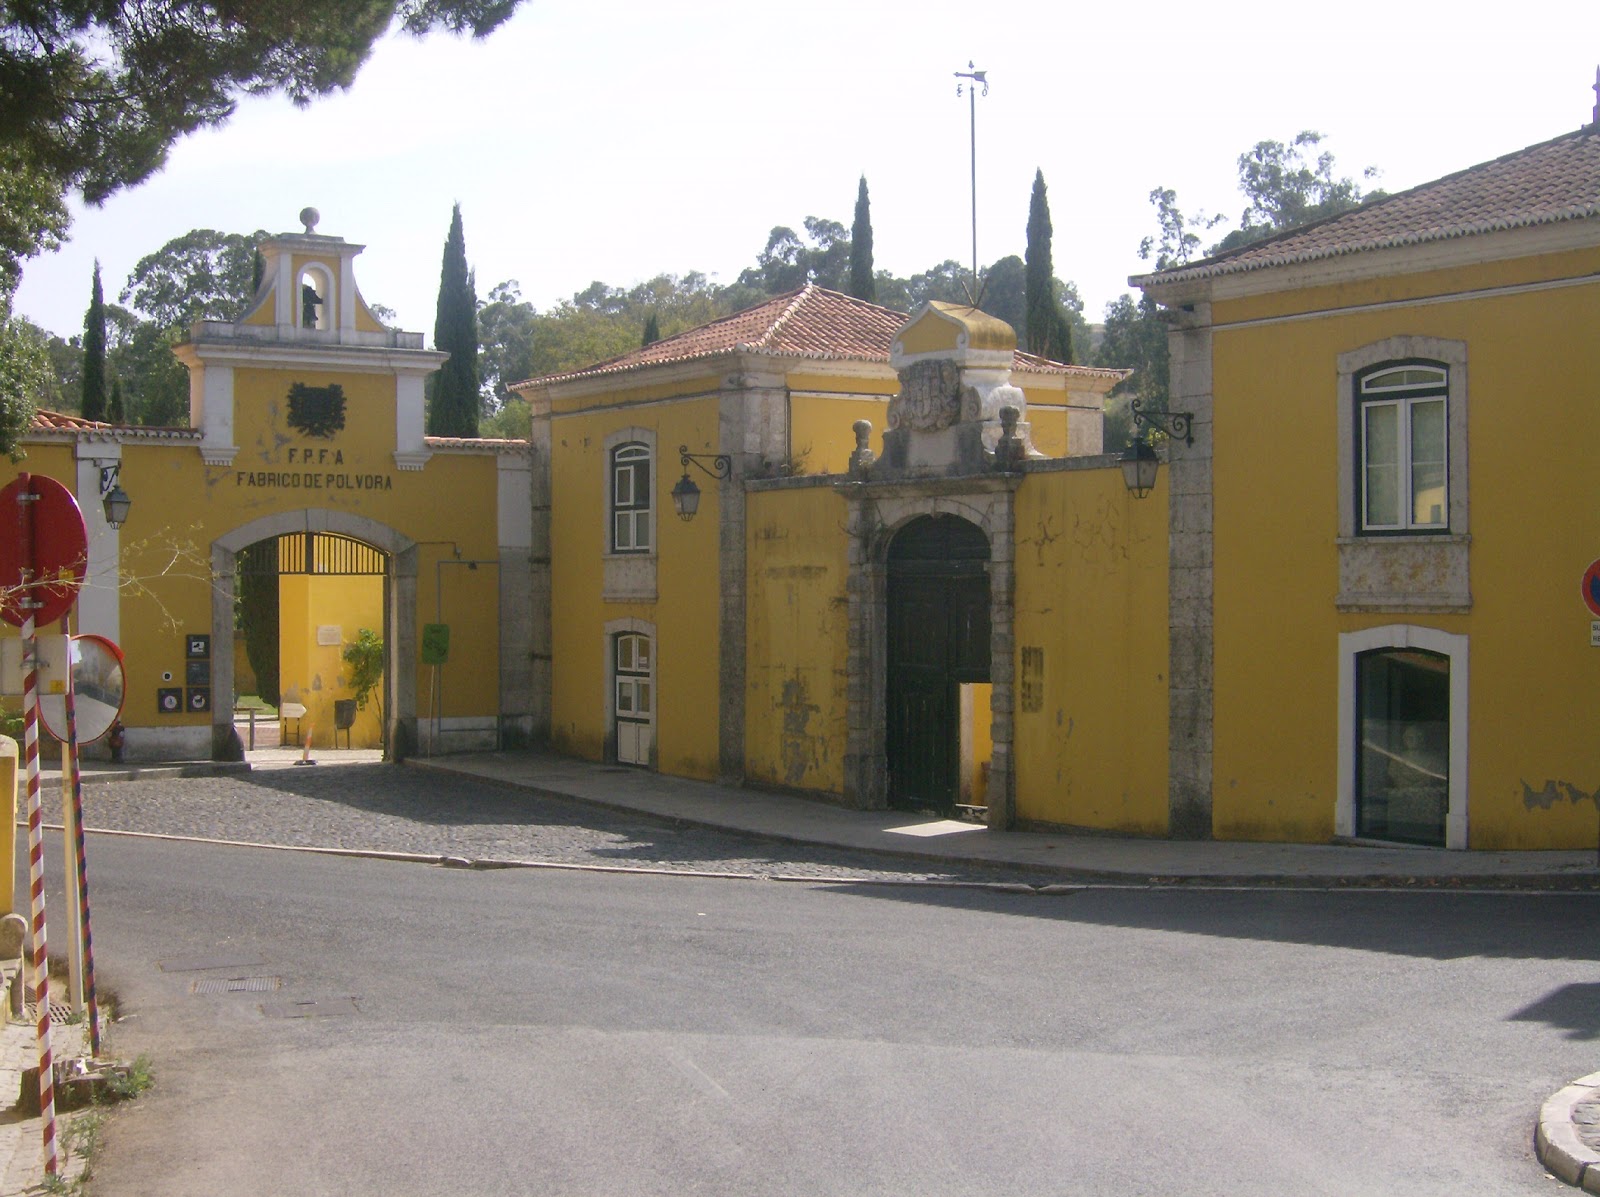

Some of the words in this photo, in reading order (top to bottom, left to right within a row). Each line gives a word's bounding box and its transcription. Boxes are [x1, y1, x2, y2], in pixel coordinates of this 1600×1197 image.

[237, 472, 300, 488] FABRICO
[304, 473, 323, 489] DE
[326, 474, 393, 490] POLVORA
